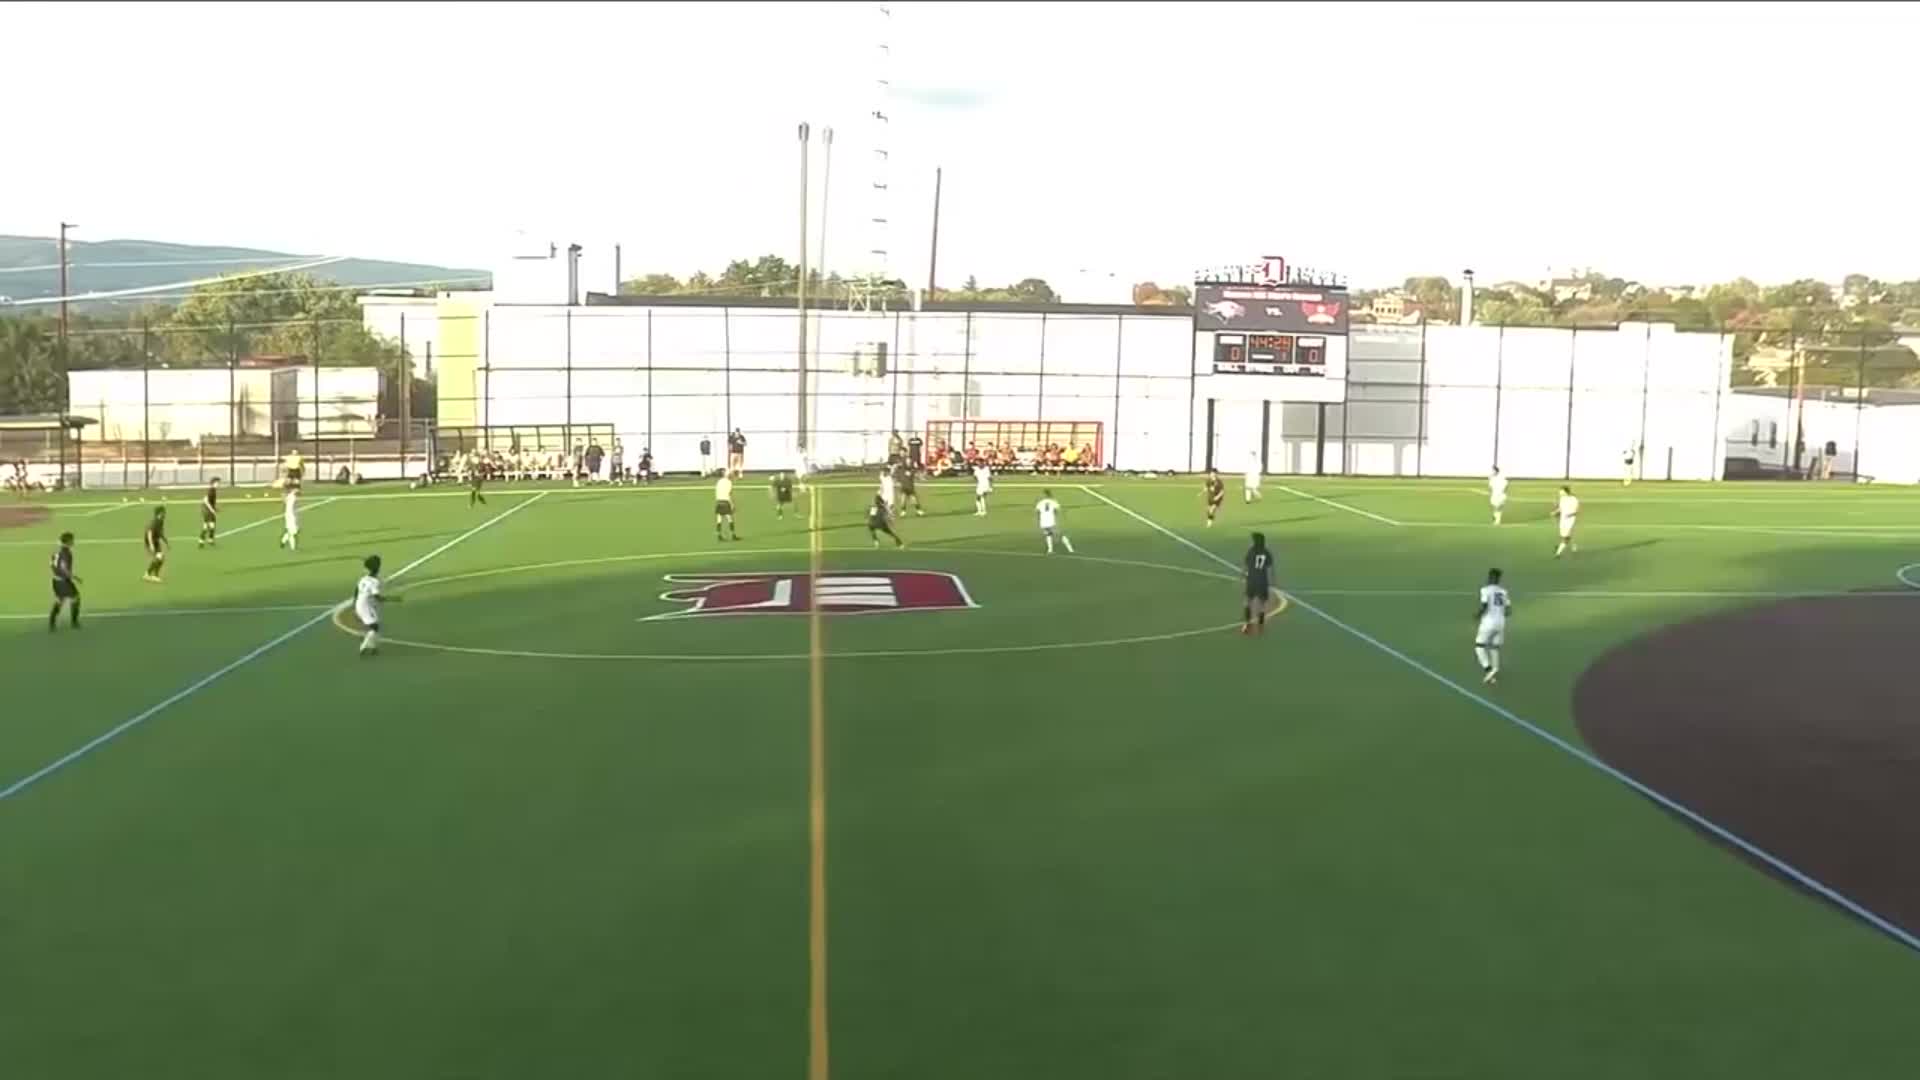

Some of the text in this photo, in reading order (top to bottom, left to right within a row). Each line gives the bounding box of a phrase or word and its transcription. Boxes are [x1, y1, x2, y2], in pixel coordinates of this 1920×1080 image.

[1231, 347, 1240, 361] 0
[1309, 349, 1318, 363] 0
[1254, 554, 1267, 569] 17
